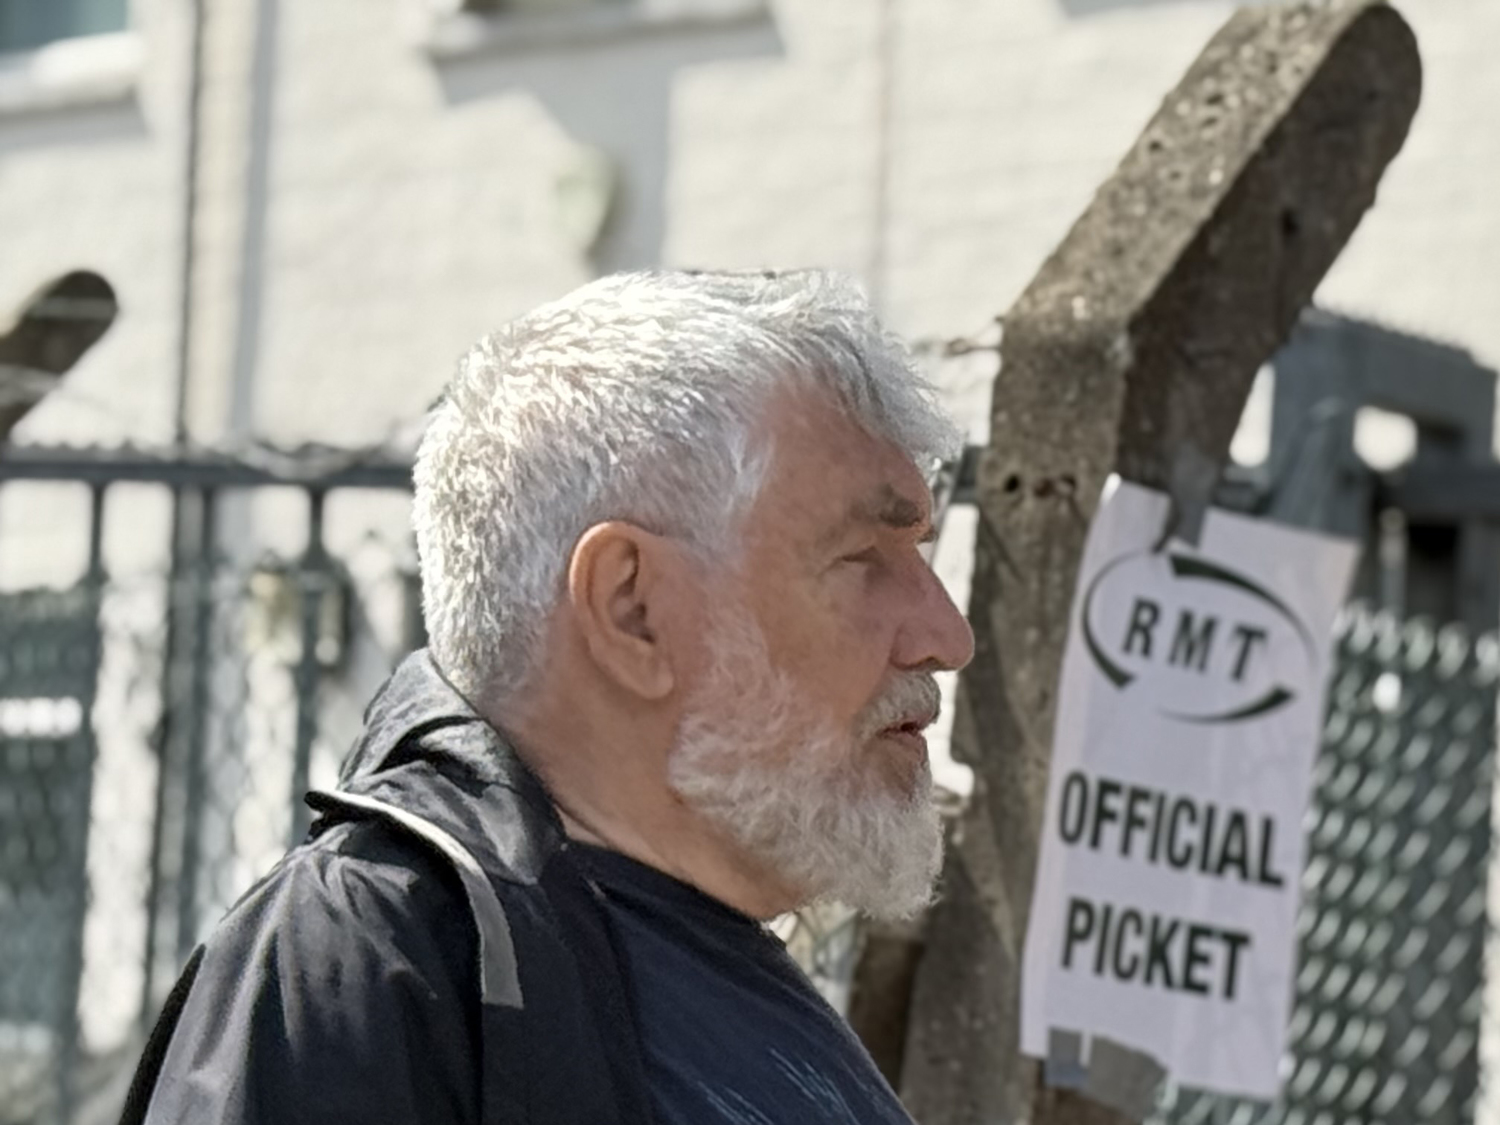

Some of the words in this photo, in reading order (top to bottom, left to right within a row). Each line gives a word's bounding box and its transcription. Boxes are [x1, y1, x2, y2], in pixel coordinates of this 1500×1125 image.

[1123, 595, 1266, 682] RMT
[1058, 772, 1284, 888] OFFICIAL
[1061, 897, 1251, 1000] PICKET
